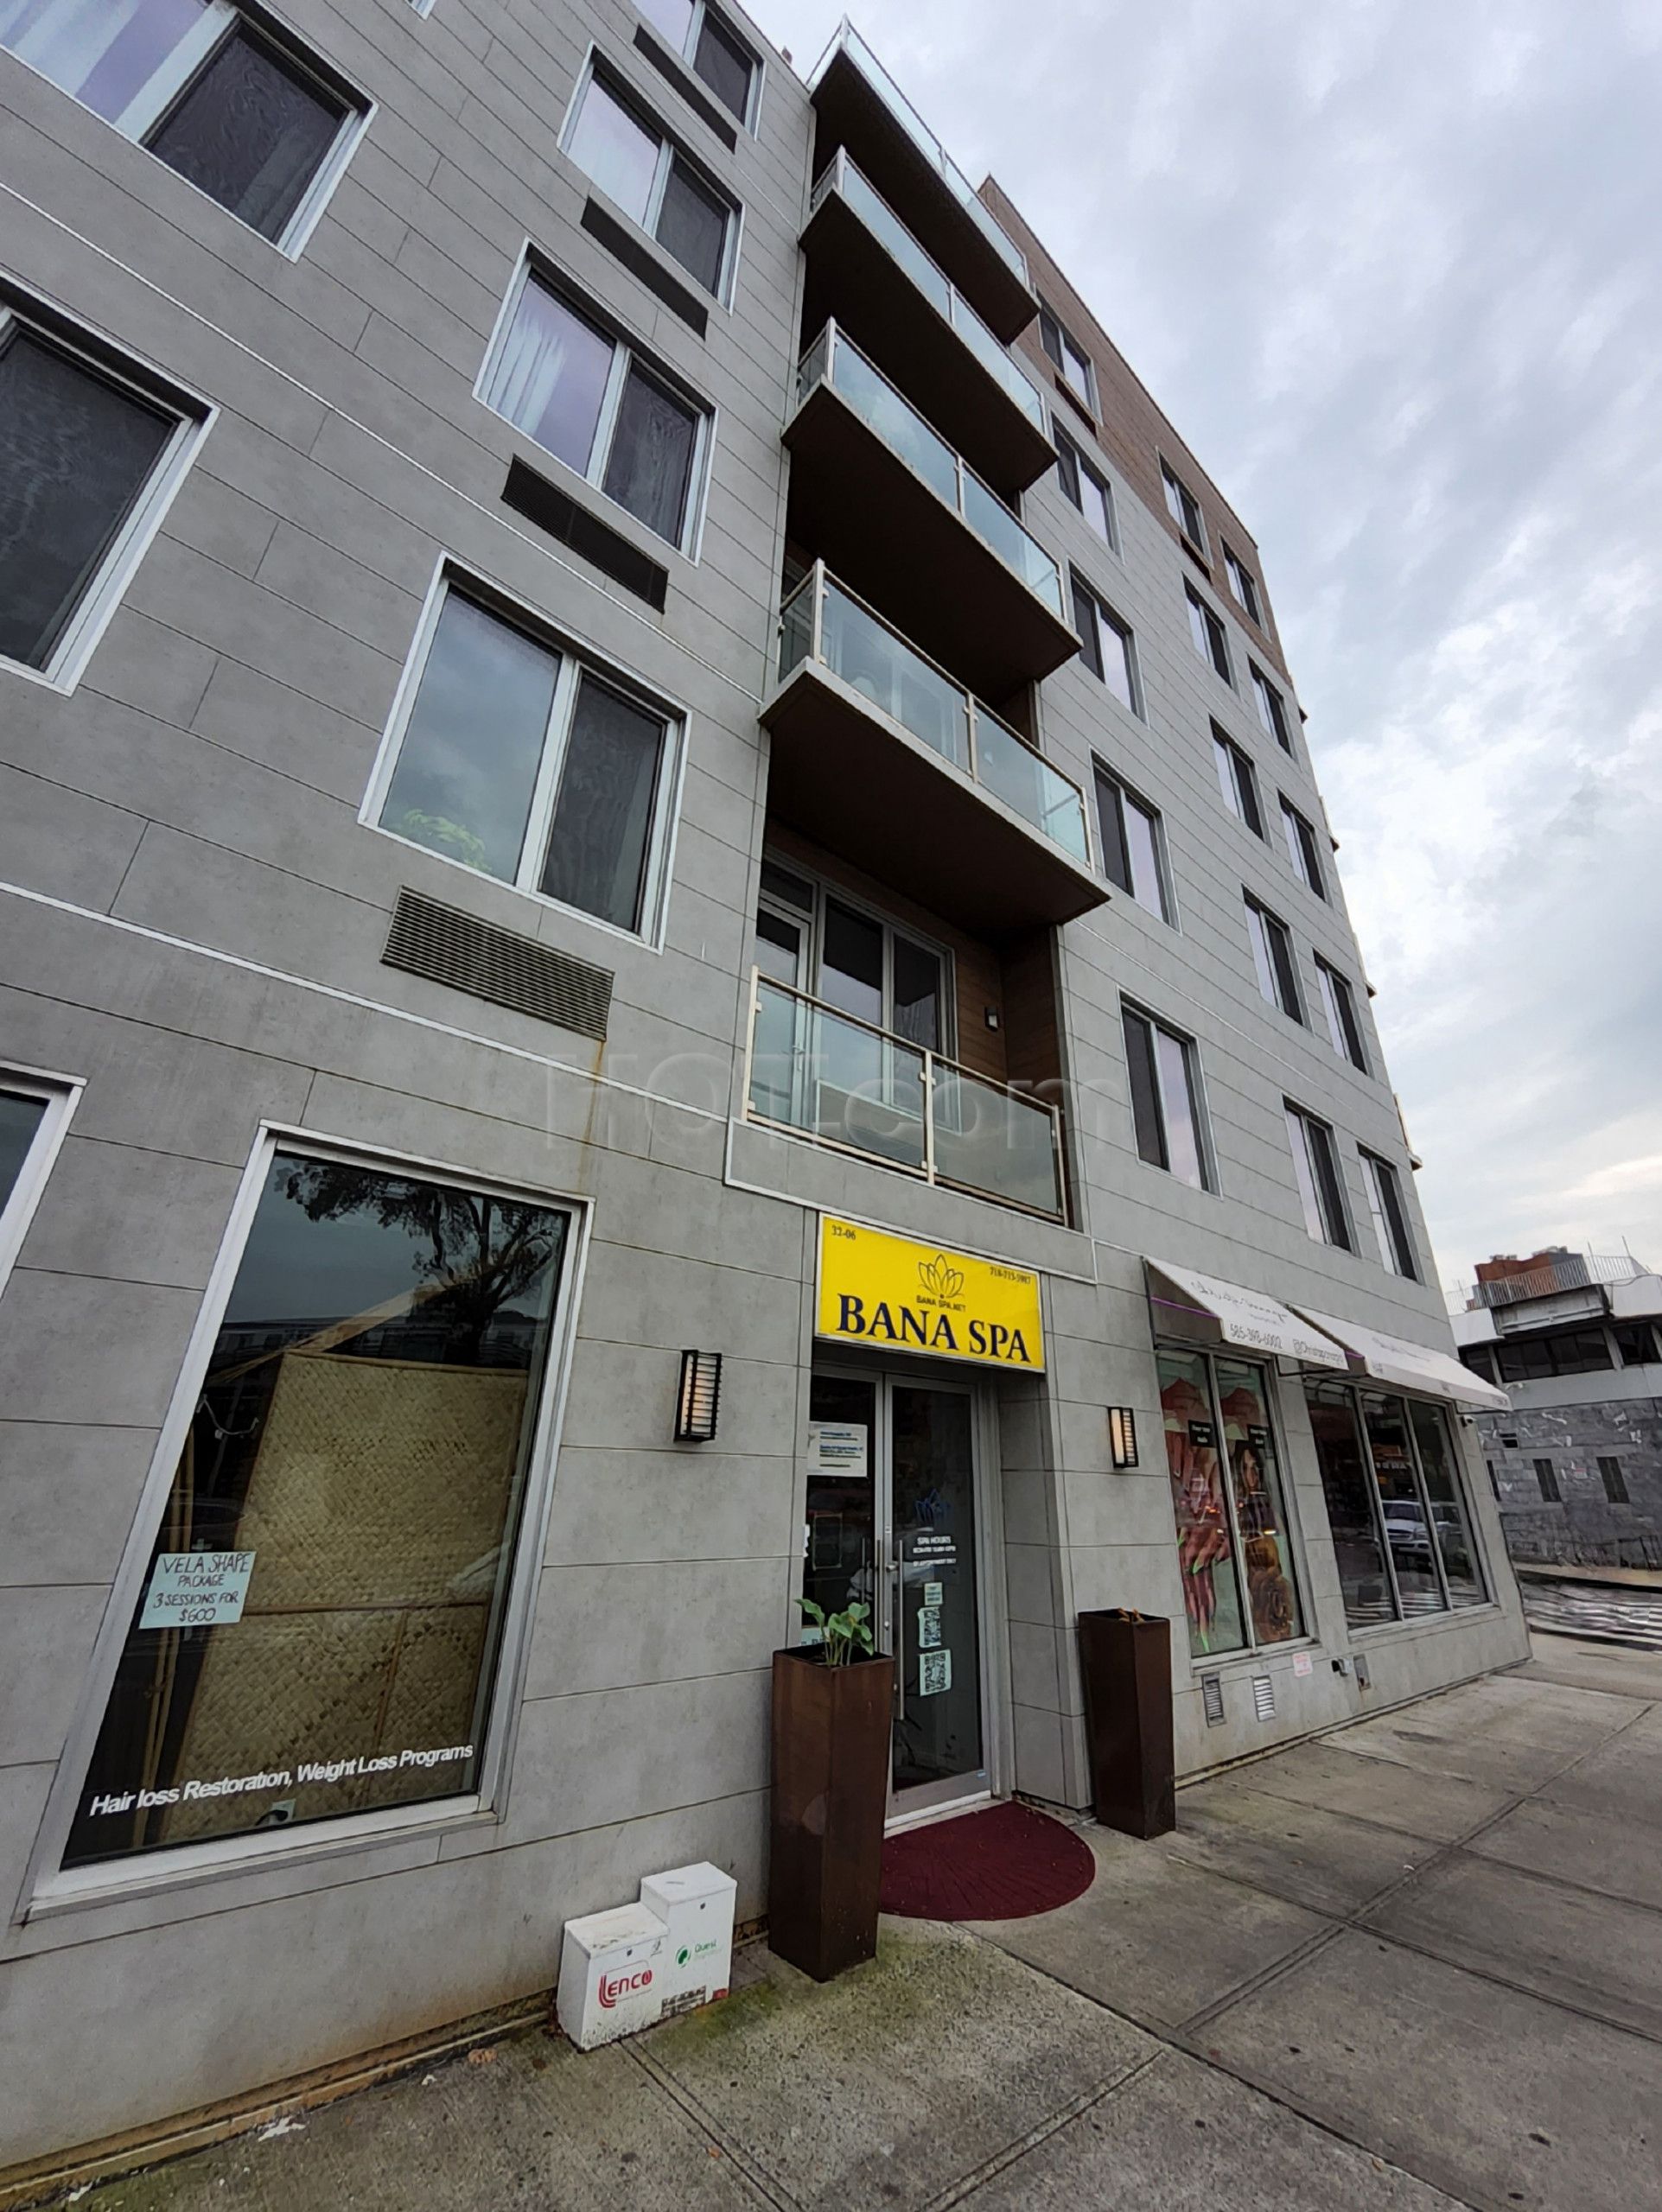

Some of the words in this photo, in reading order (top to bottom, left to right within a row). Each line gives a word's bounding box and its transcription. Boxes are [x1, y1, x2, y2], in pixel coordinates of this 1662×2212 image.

[916, 1294, 936, 1306] BANA
[837, 1293, 959, 1351] BANA
[969, 1319, 1032, 1363] SPA
[163, 1555, 205, 1573] VELA
[208, 1552, 252, 1573] SHAPE
[176, 1573, 226, 1587] PACKAGE
[153, 1592, 164, 1608] 3
[164, 1592, 218, 1606] SESSIONS
[218, 1590, 239, 1604] FOR
[179, 1607, 217, 1623] $600
[89, 1791, 136, 1816] Hair
[136, 1788, 180, 1809] loss
[182, 1770, 292, 1801] Restoration,
[297, 1758, 357, 1783] Weight
[357, 1755, 398, 1773] Loss
[399, 1745, 474, 1768] Programs
